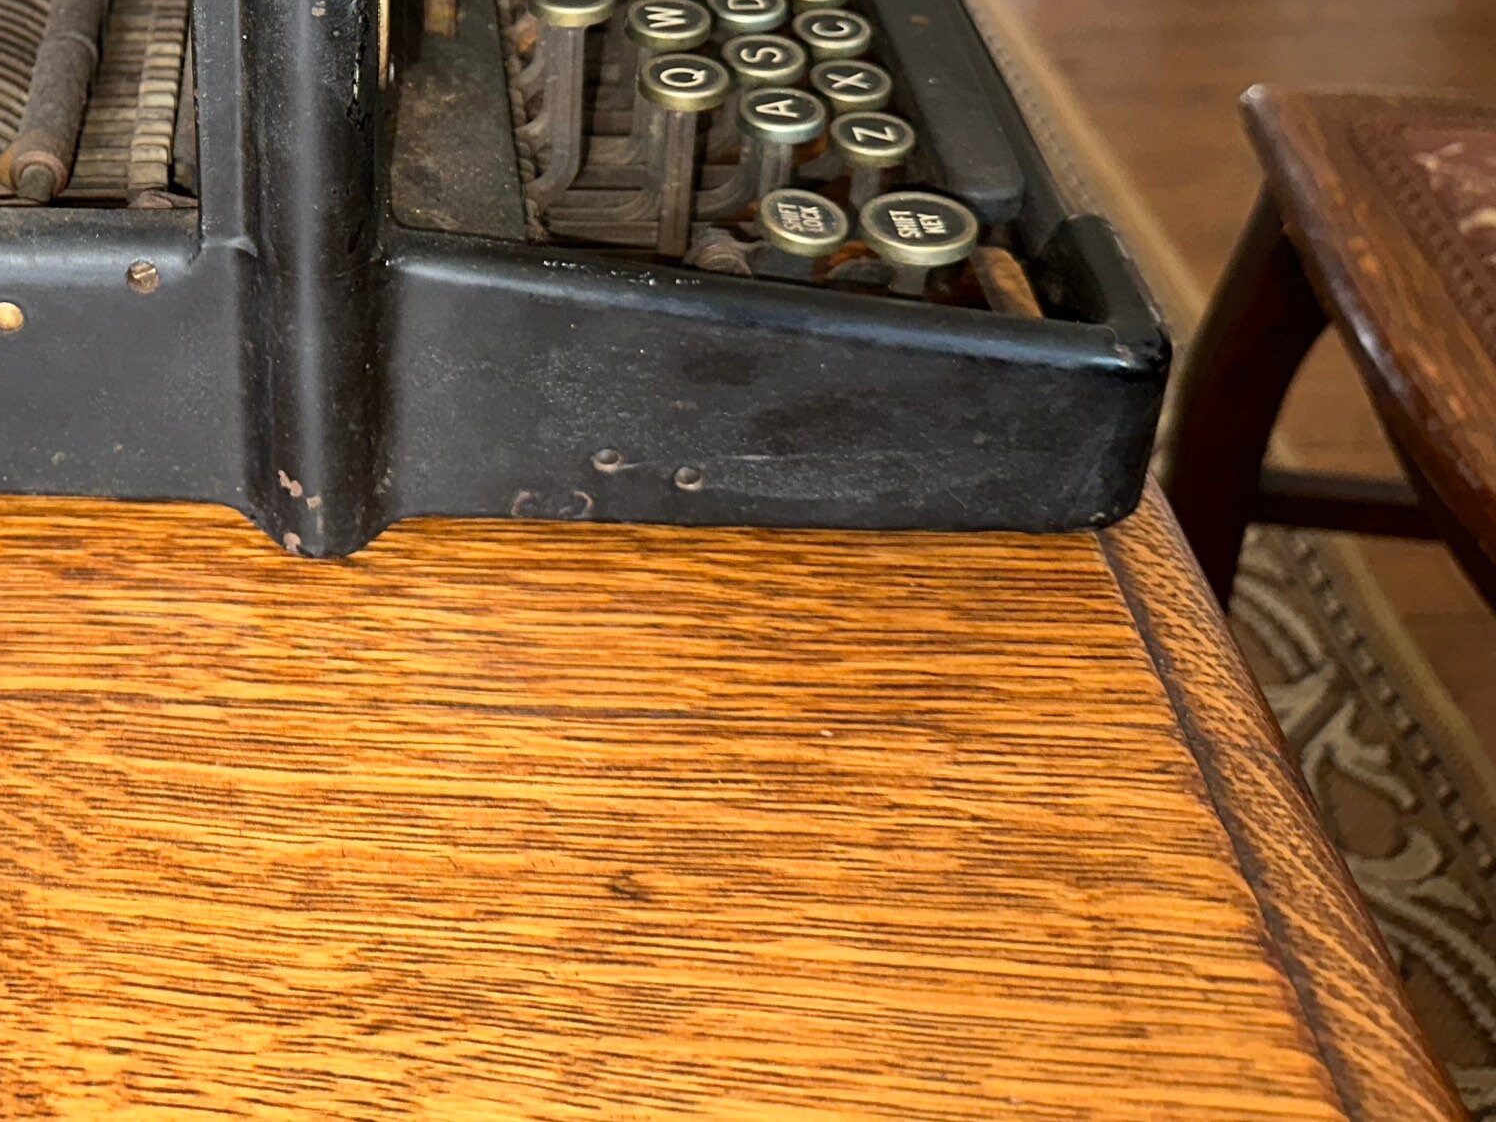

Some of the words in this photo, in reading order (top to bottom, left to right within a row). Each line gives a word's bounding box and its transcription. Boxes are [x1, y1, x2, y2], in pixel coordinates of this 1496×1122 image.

[643, 5, 688, 29] W
[811, 20, 853, 38] C
[739, 46, 784, 64] S
[659, 67, 708, 88] Q
[825, 71, 873, 90] X
[755, 98, 801, 119] A
[851, 125, 897, 144] Z
[777, 202, 805, 232] SHIFT
[798, 205, 826, 233] LOCK
[888, 209, 924, 239] SHIFT
[916, 213, 947, 235] KEY
